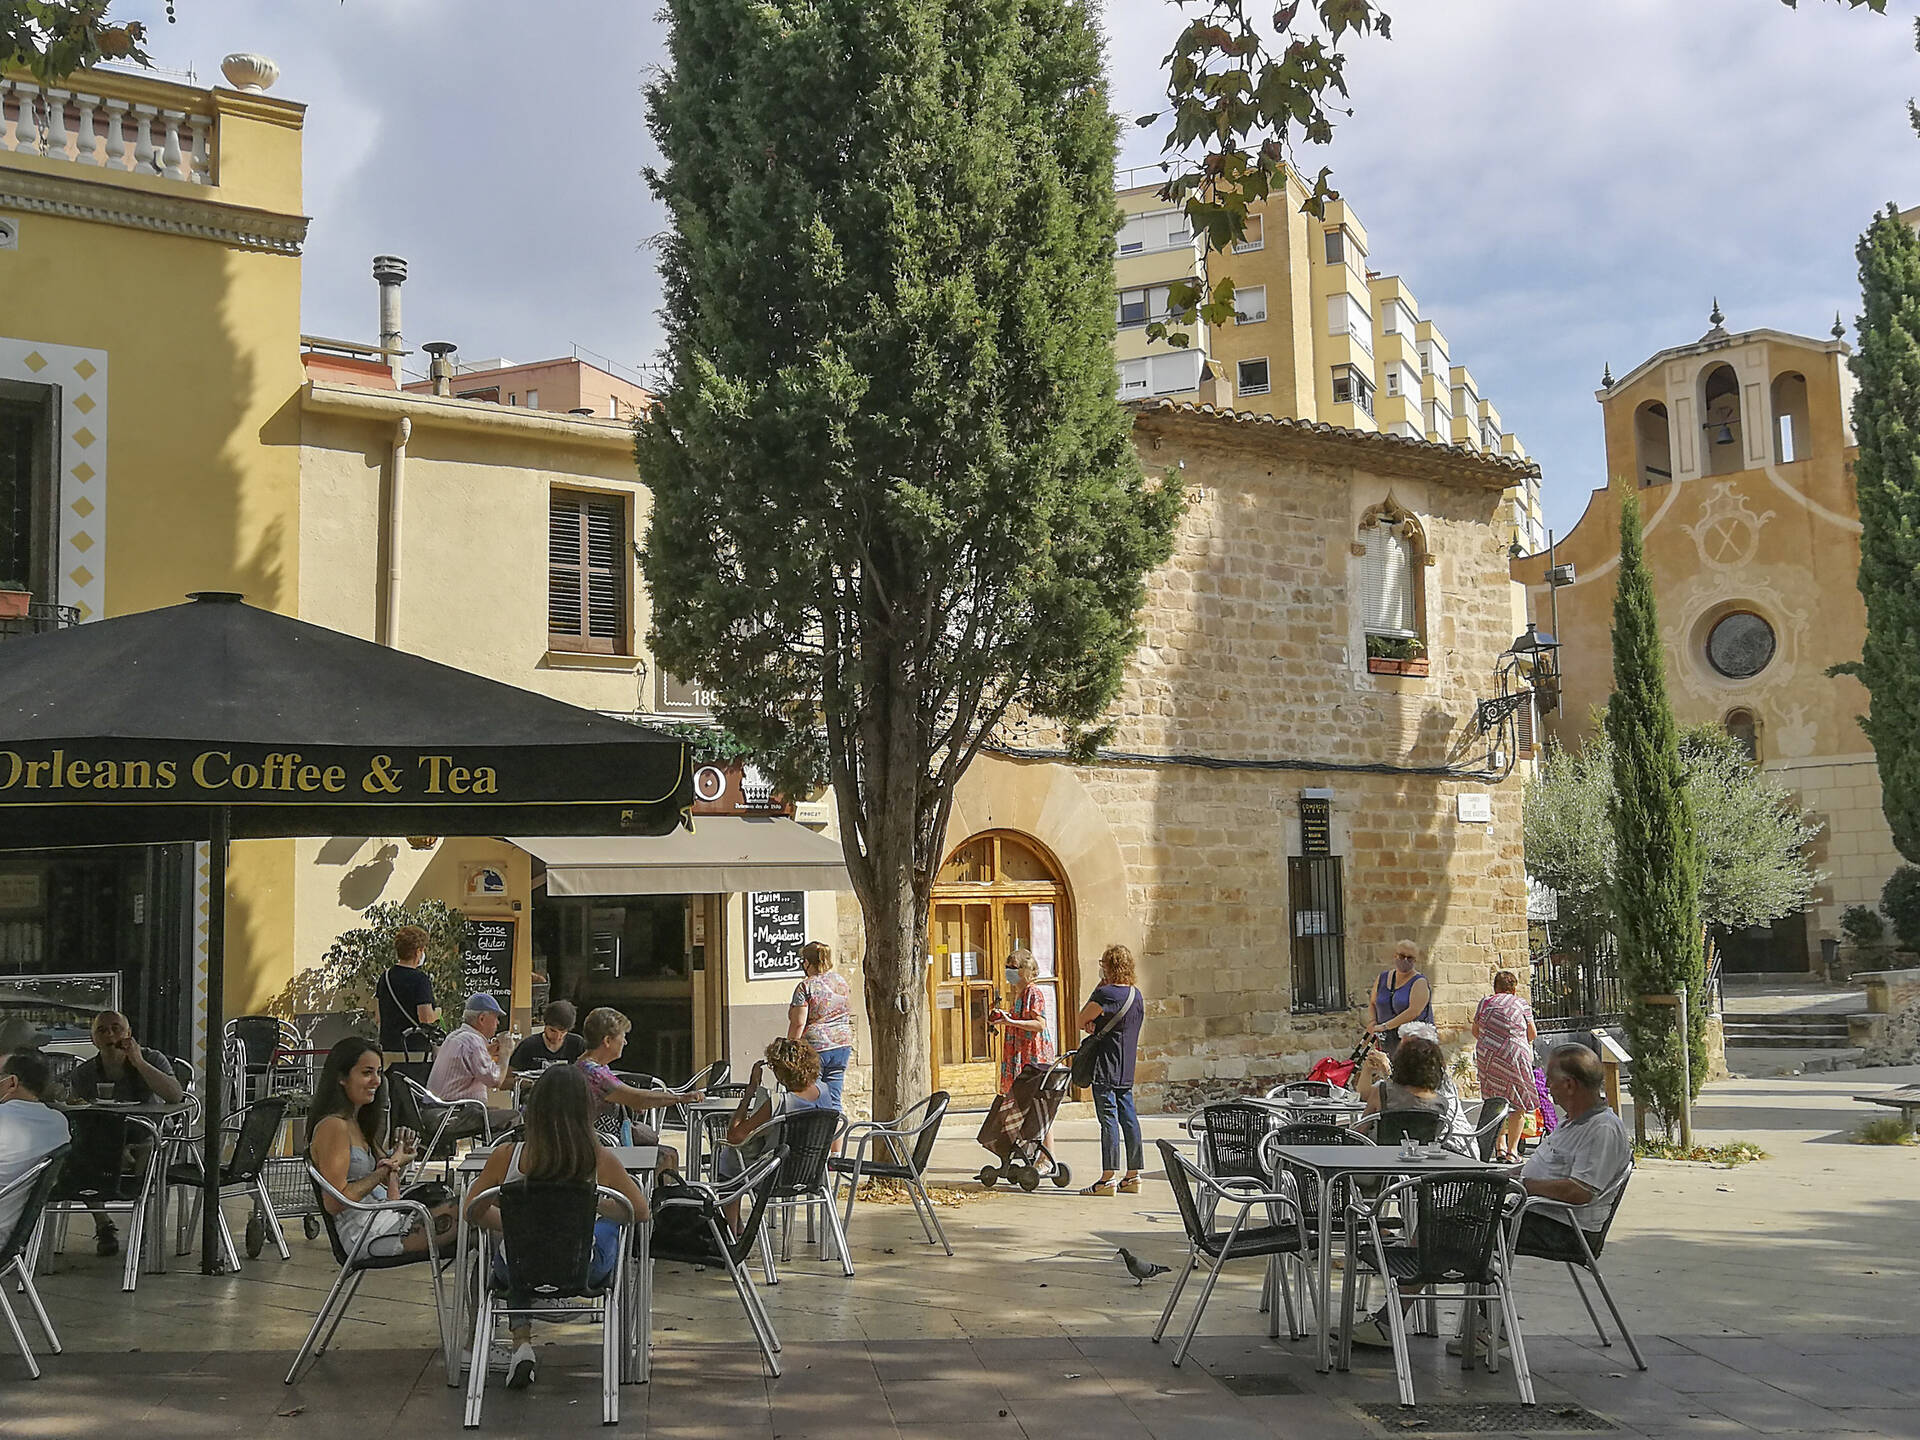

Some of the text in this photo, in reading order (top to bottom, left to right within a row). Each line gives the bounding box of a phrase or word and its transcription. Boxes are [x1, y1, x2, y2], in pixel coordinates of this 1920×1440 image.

[0, 749, 499, 794] Orleans Coffee & Tea
